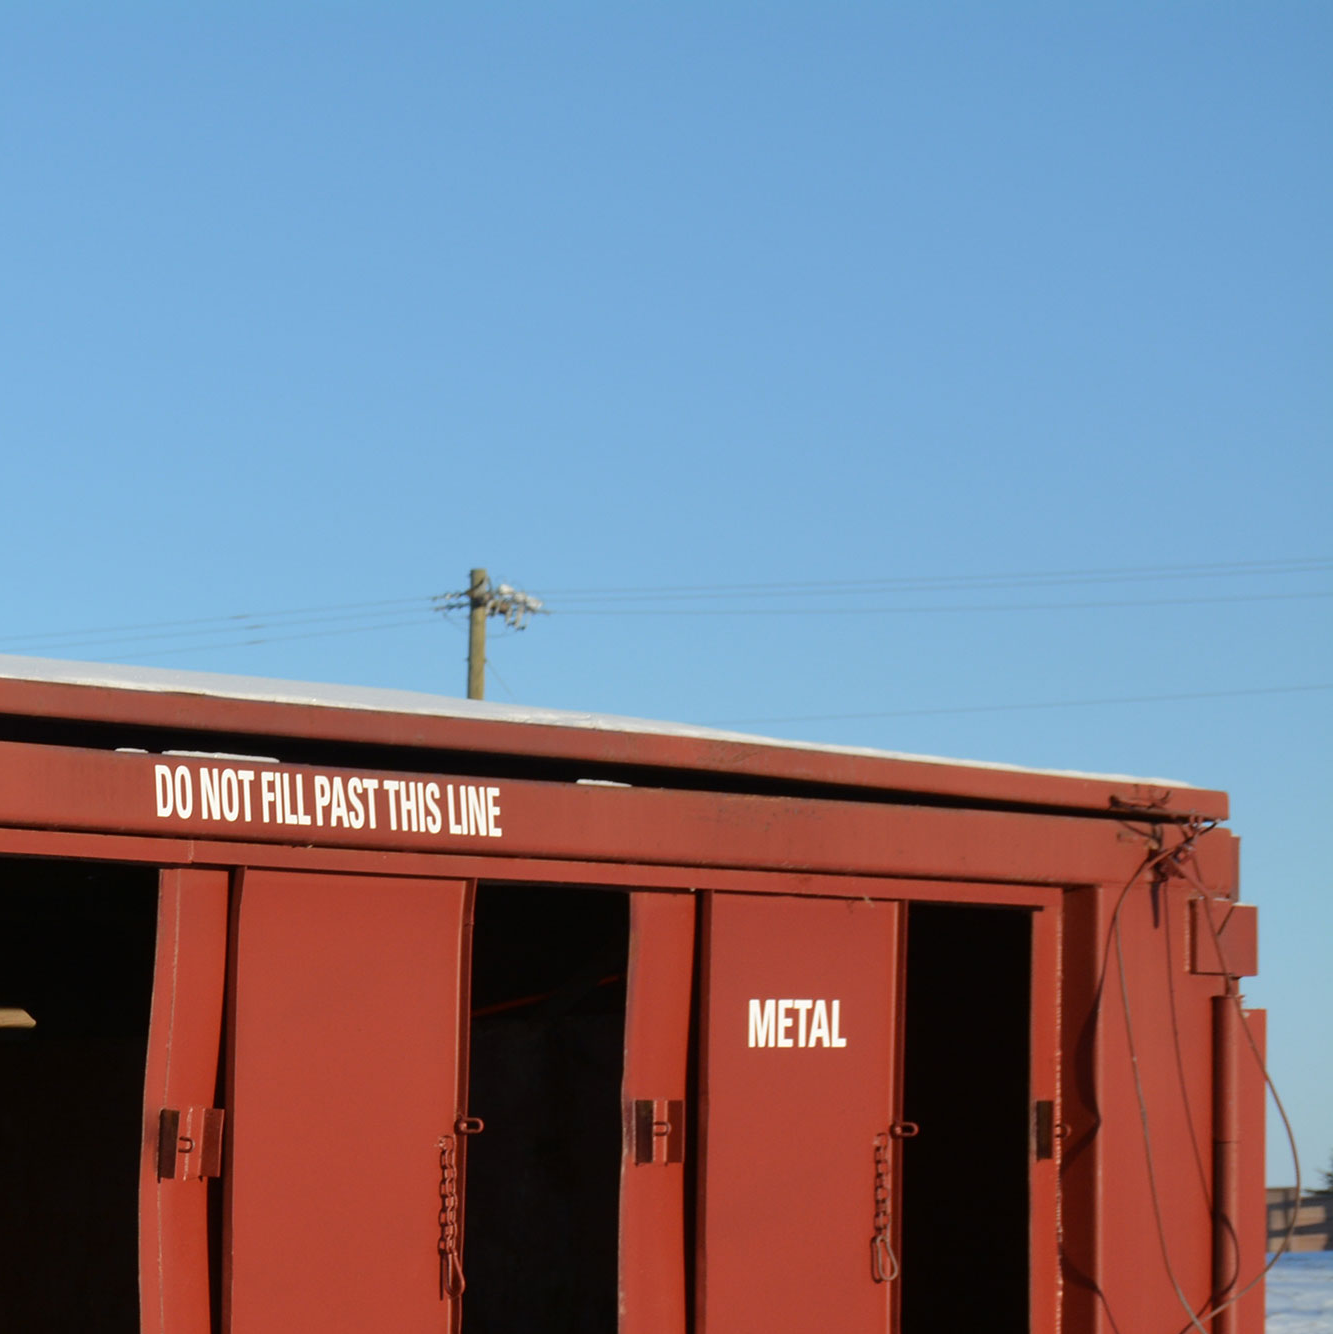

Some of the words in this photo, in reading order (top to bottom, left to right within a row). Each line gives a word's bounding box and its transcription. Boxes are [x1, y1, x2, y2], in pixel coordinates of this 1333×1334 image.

[154, 764, 193, 819] DO
[199, 767, 255, 822] NOT
[260, 771, 312, 826] FILL
[314, 775, 379, 829] PAST
[383, 779, 443, 834] THIS
[447, 784, 503, 837] LINE
[747, 998, 848, 1048] METAL
